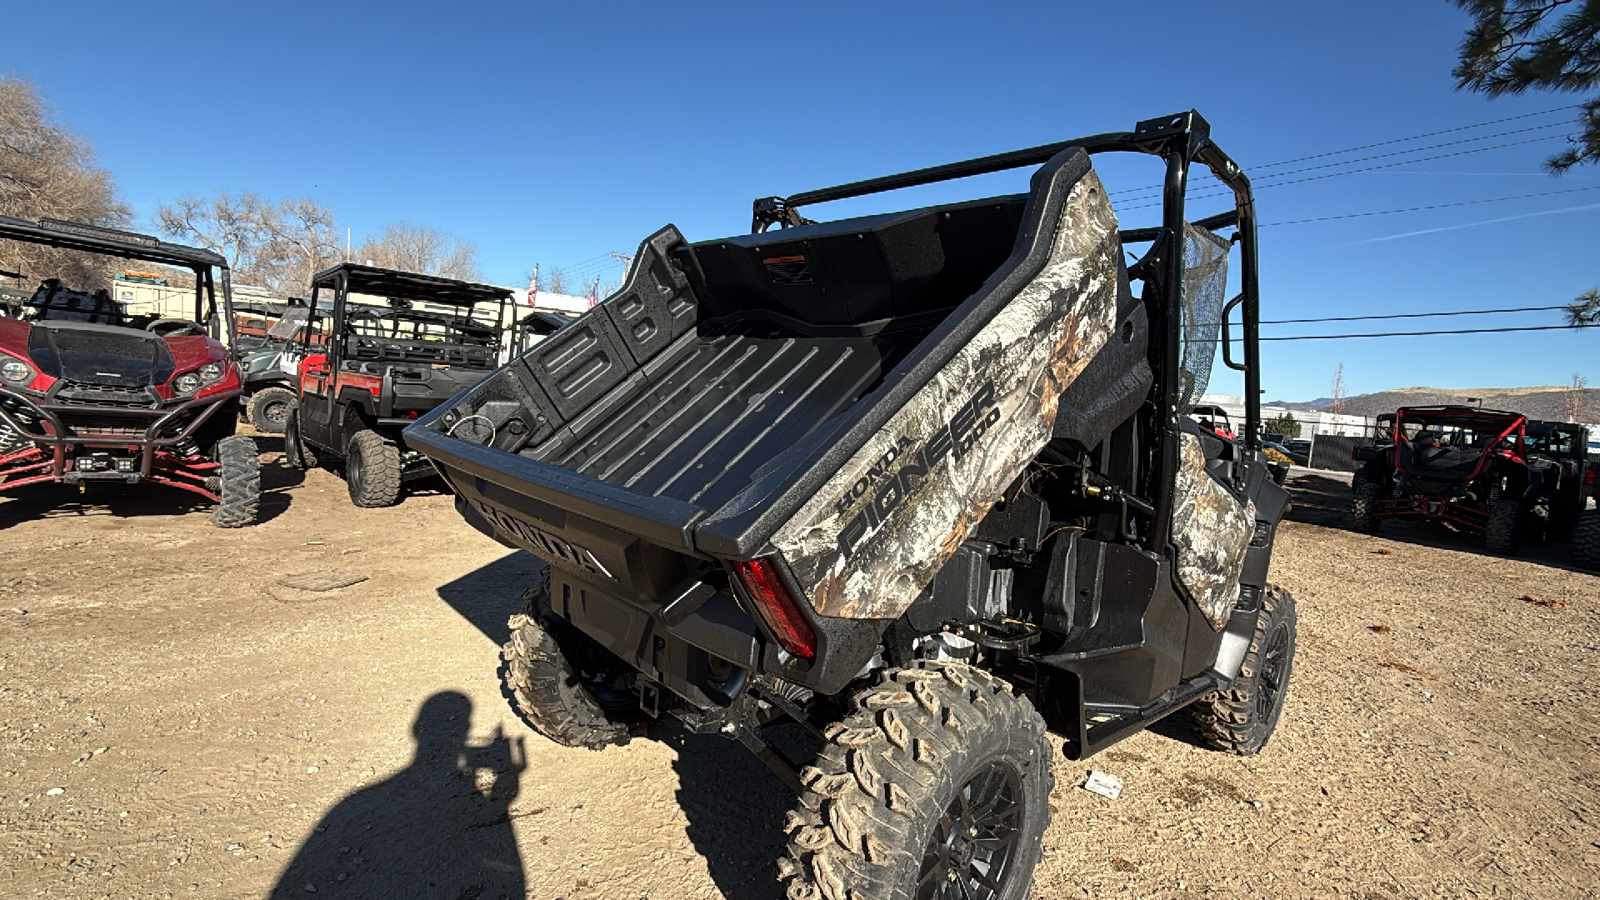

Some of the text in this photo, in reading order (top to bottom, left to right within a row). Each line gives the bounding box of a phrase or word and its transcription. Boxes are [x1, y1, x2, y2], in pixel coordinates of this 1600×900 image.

[834, 435, 914, 517] HONDA
[836, 376, 999, 558] PIONEER
[951, 407, 1001, 463] 1000
[473, 498, 620, 583] HONDA
